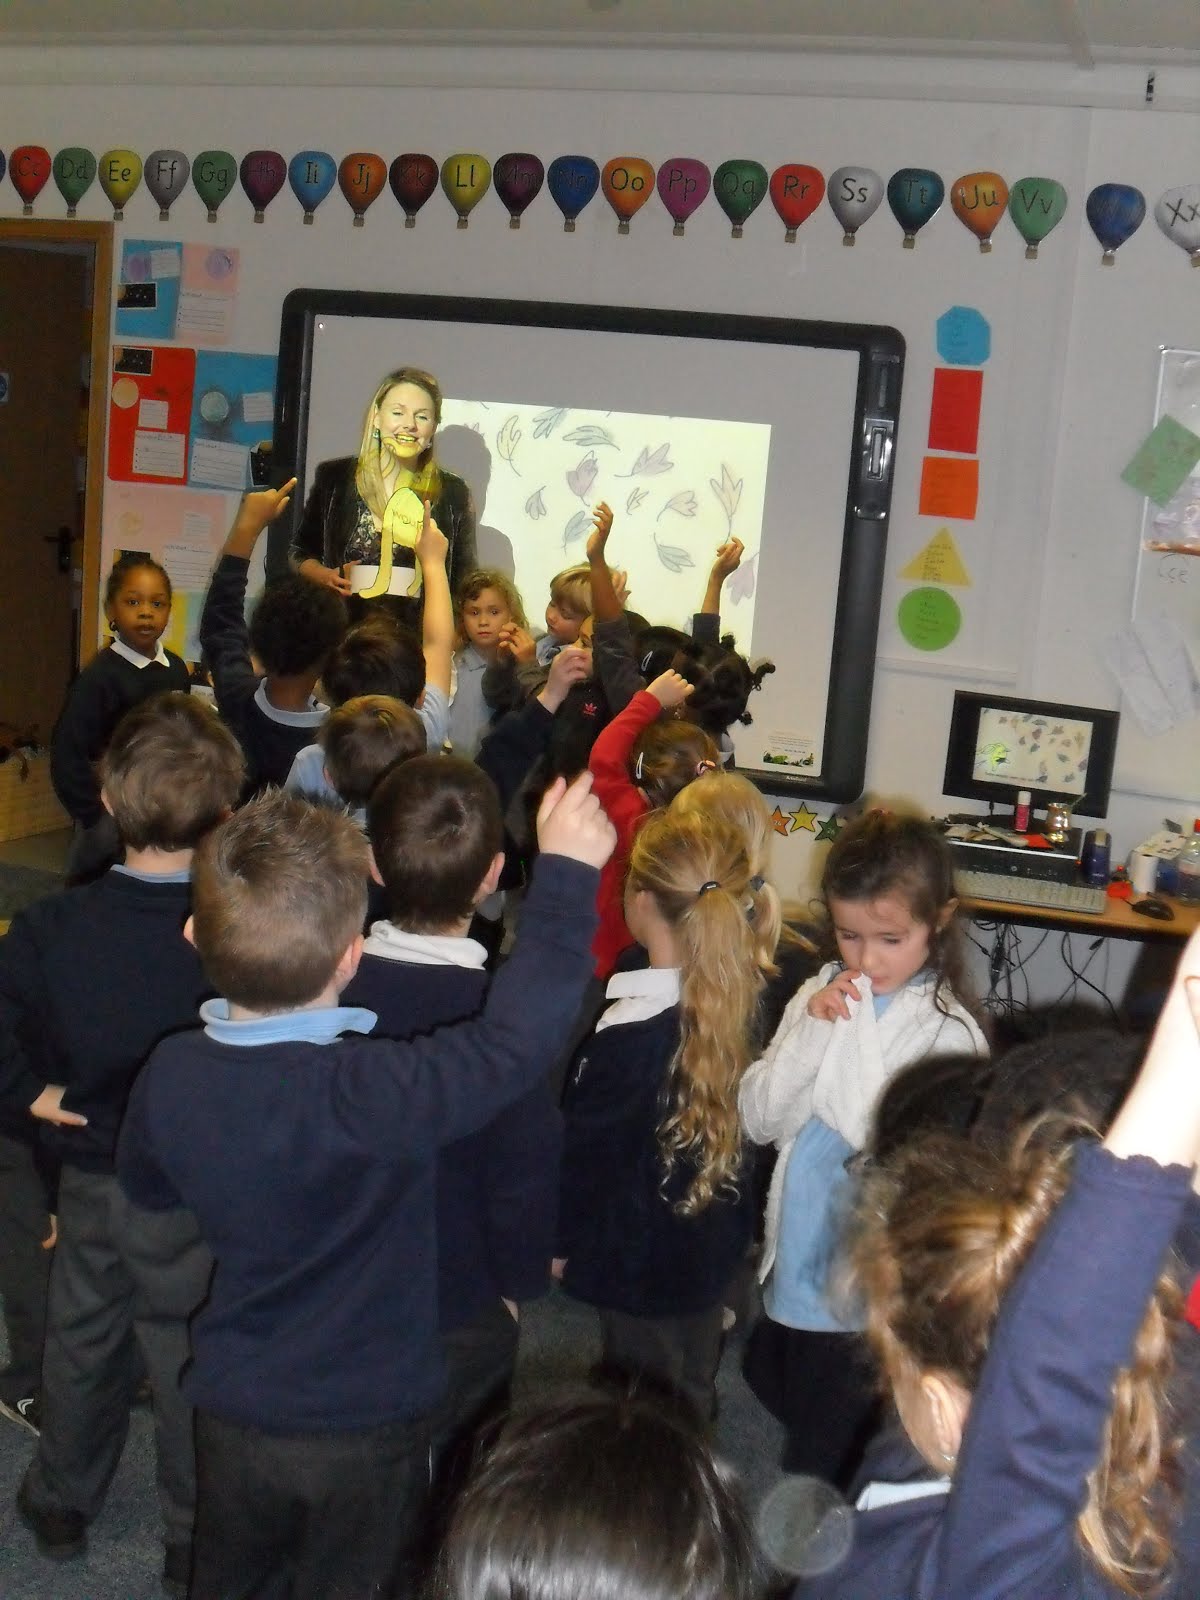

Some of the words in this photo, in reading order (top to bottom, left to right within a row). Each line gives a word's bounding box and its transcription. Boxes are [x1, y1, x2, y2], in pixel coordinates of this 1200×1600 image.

[60, 159, 89, 181] Dd
[109, 160, 131, 182] Ee
[157, 160, 177, 189] Ff
[200, 161, 229, 191] Gg
[305, 161, 319, 184] Ii
[352, 163, 371, 194] Jj
[456, 164, 475, 188] Ll
[610, 167, 645, 191] Oo
[669, 169, 697, 201] Pp
[721, 171, 755, 202] Qq
[783, 174, 810, 199] Rr
[841, 177, 868, 203] Ss
[903, 179, 928, 205] Tt
[961, 184, 1000, 210] Uu
[1020, 188, 1053, 214] Vv
[1165, 198, 1200, 226] Xx
